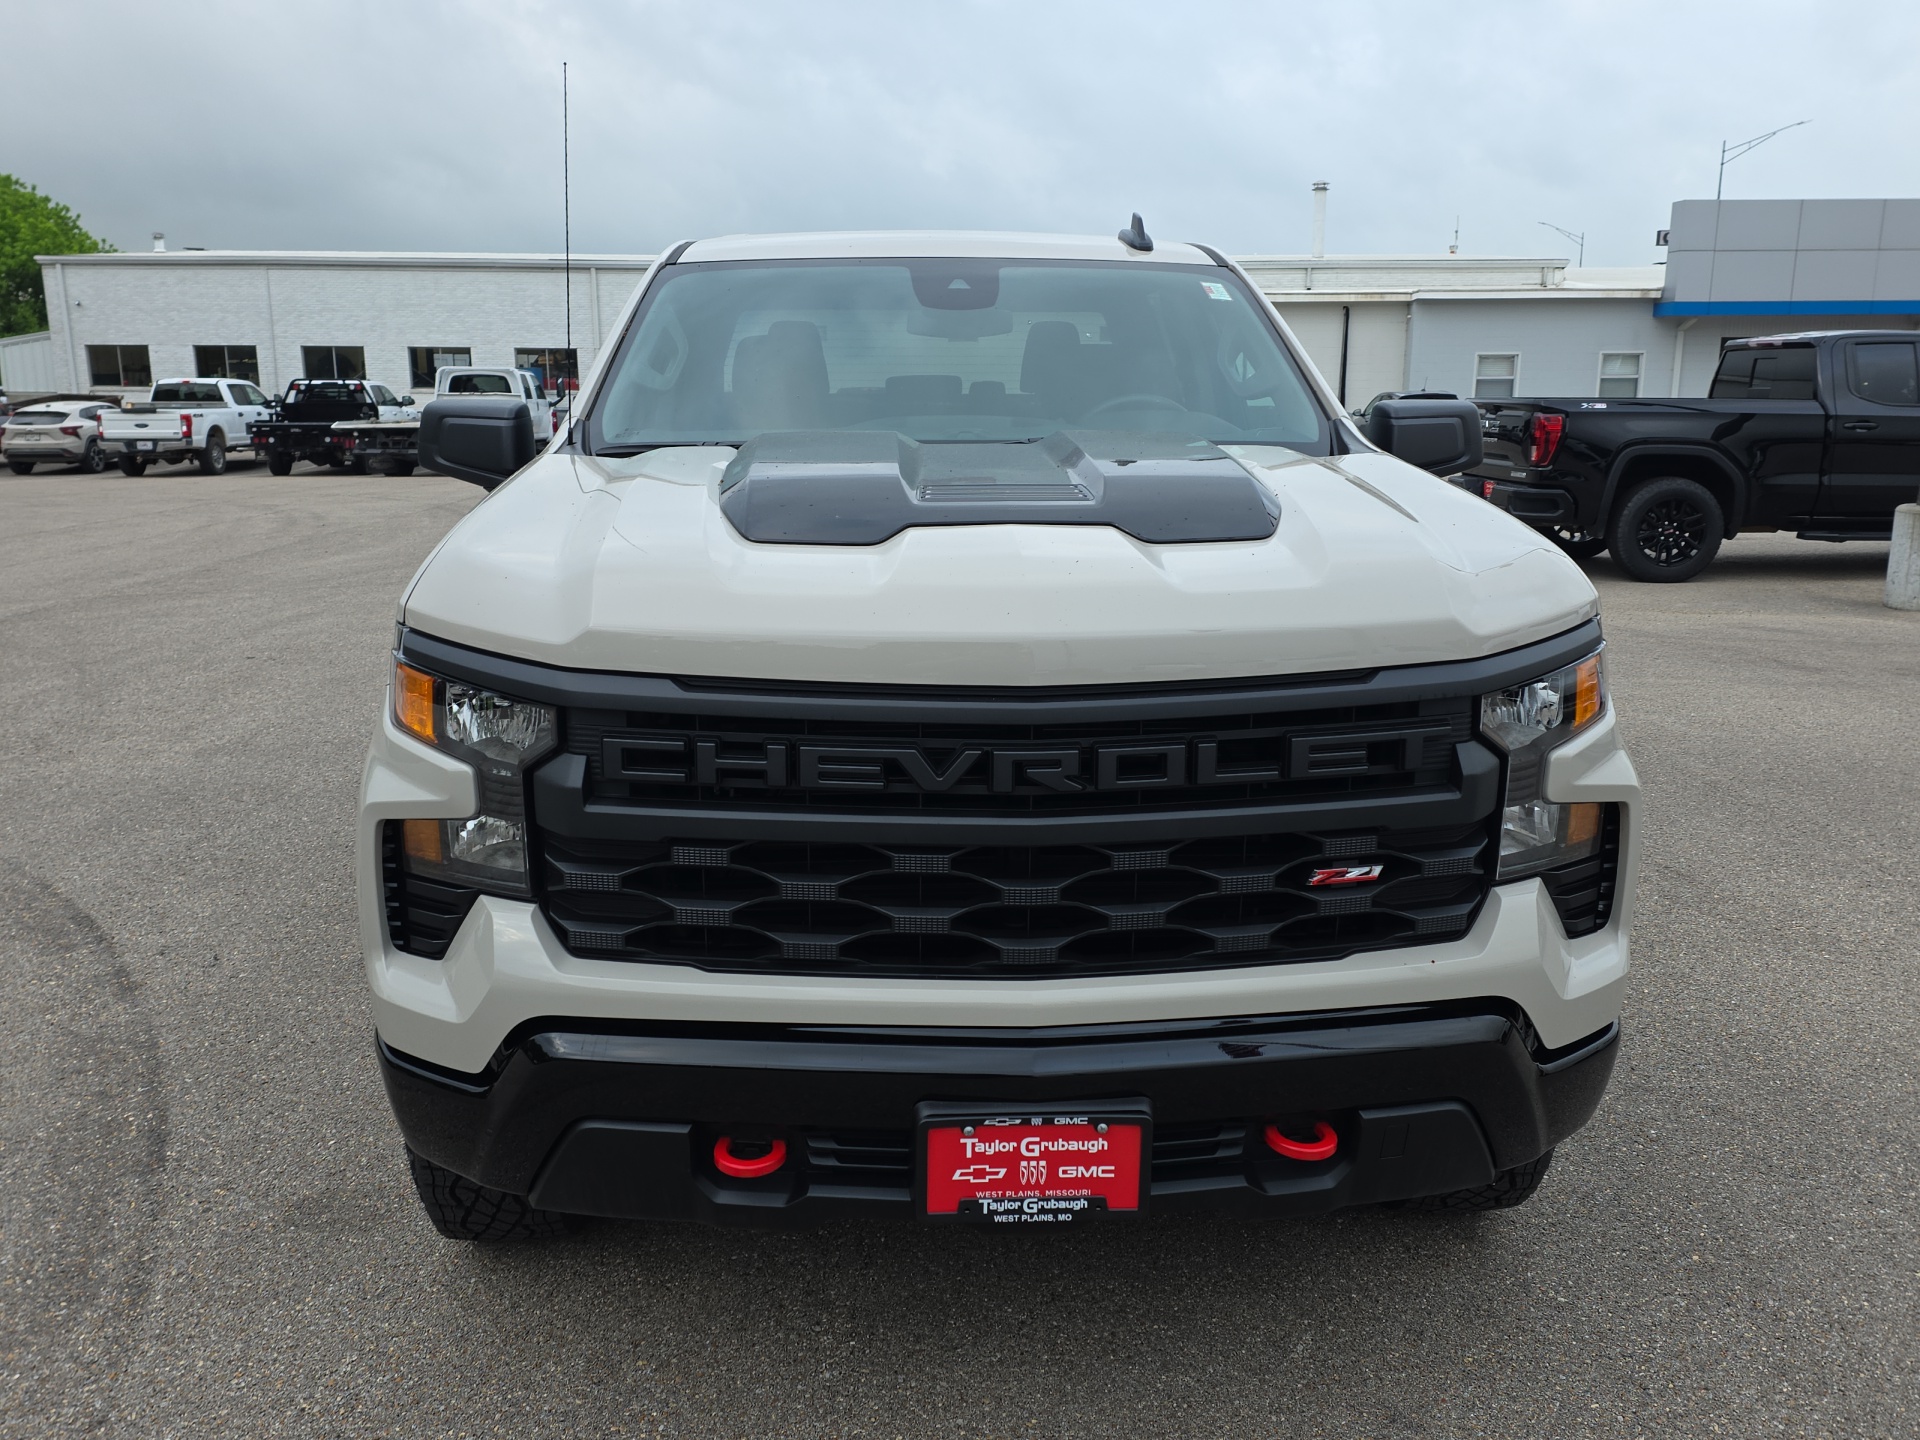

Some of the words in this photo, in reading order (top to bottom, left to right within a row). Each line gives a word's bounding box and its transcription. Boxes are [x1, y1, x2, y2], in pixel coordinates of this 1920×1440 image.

[602, 720, 1452, 792] CHEVROLET
[1306, 865, 1384, 886] Z71
[1054, 1117, 1088, 1125] GMC
[960, 1137, 1017, 1159] Taylor
[1020, 1136, 1108, 1157] Grubaugh
[1058, 1165, 1115, 1178] GMC
[975, 1190, 1003, 1198] WEST
[1005, 1190, 1043, 1198] PLAINS,
[1045, 1189, 1091, 1197] MISSOURI
[979, 1199, 1021, 1214] Taylor
[1023, 1198, 1088, 1213] Grubaugh
[993, 1215, 1020, 1223] WEST
[1021, 1214, 1056, 1223] PLAINS,
[1057, 1213, 1073, 1222] MO
